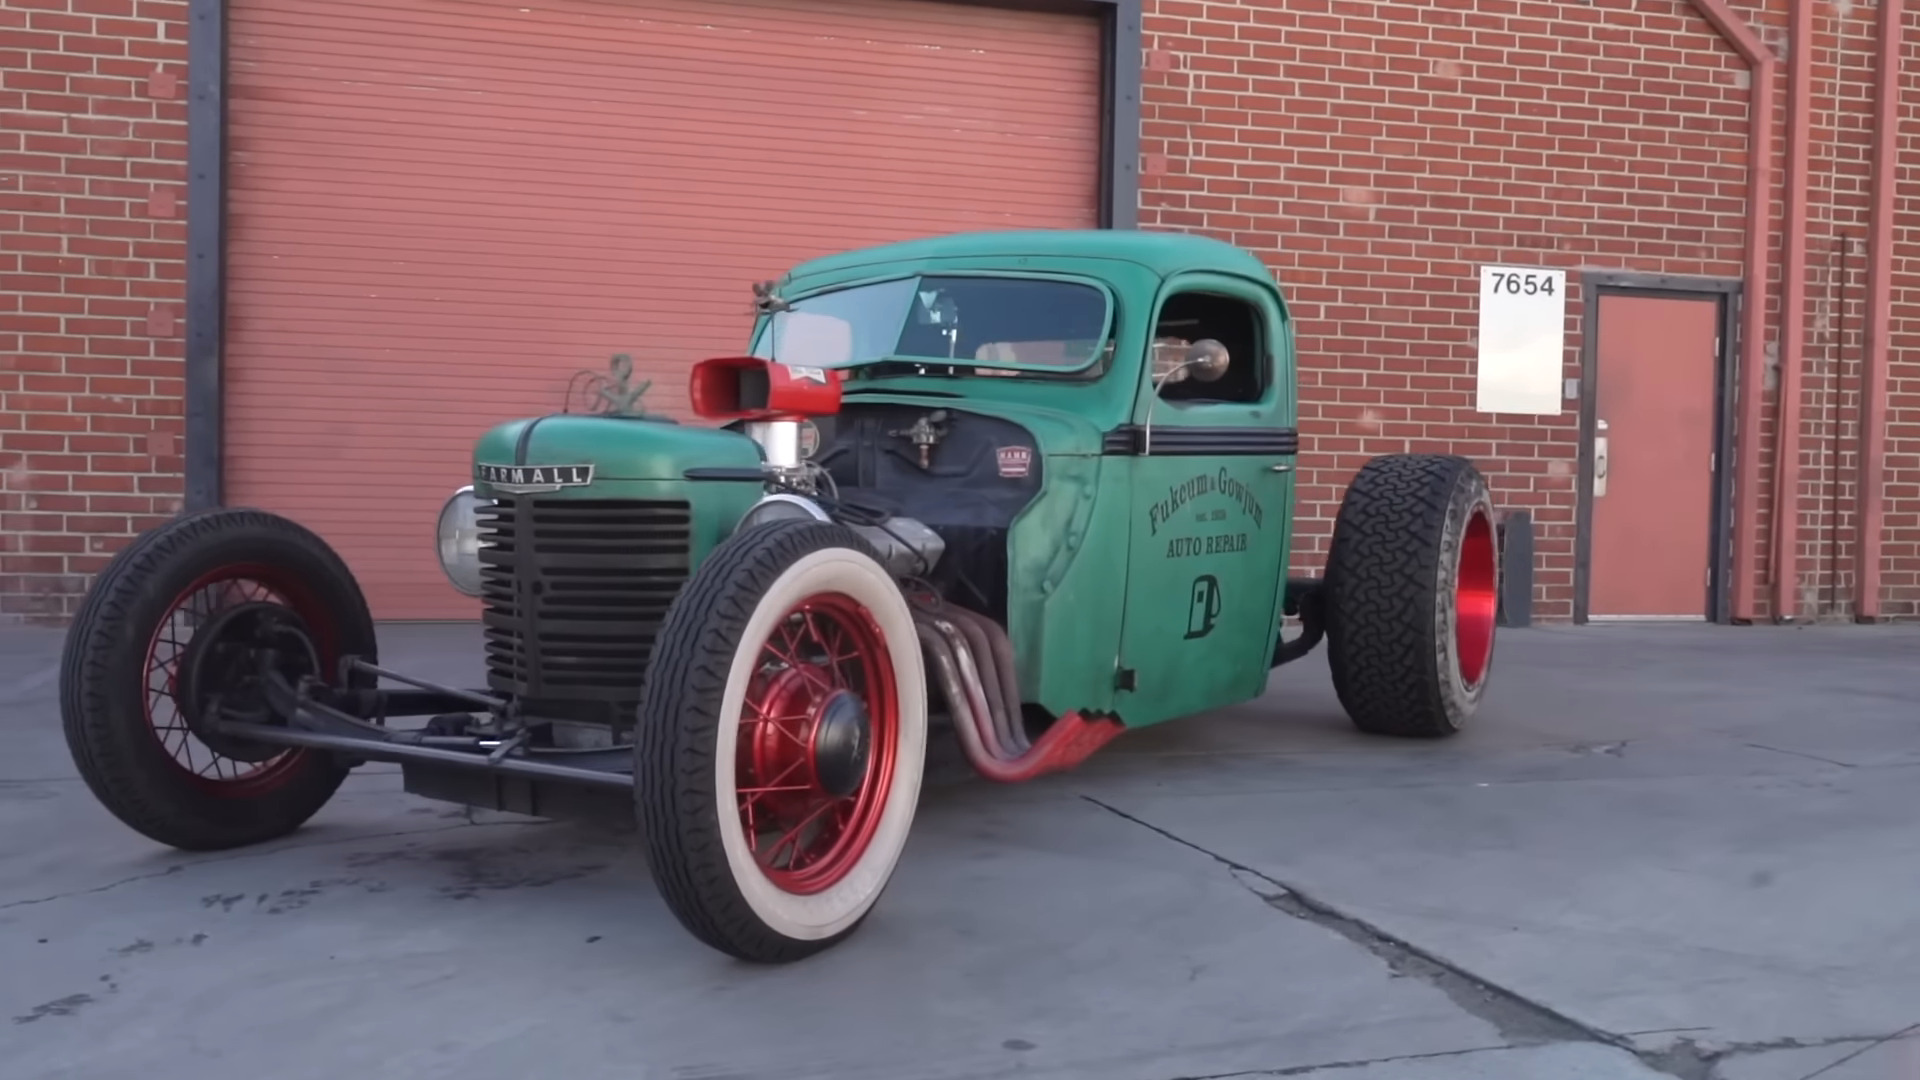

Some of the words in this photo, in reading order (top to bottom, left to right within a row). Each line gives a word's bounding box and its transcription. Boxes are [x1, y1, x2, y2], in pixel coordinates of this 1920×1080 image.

[1492, 272, 1554, 297] 7654
[481, 467, 582, 483] FARMALL
[1149, 473, 1207, 537] Fukcum
[1218, 466, 1263, 530] Gowjum
[1166, 537, 1202, 559] AUTO
[1206, 533, 1247, 554] REPAIR
